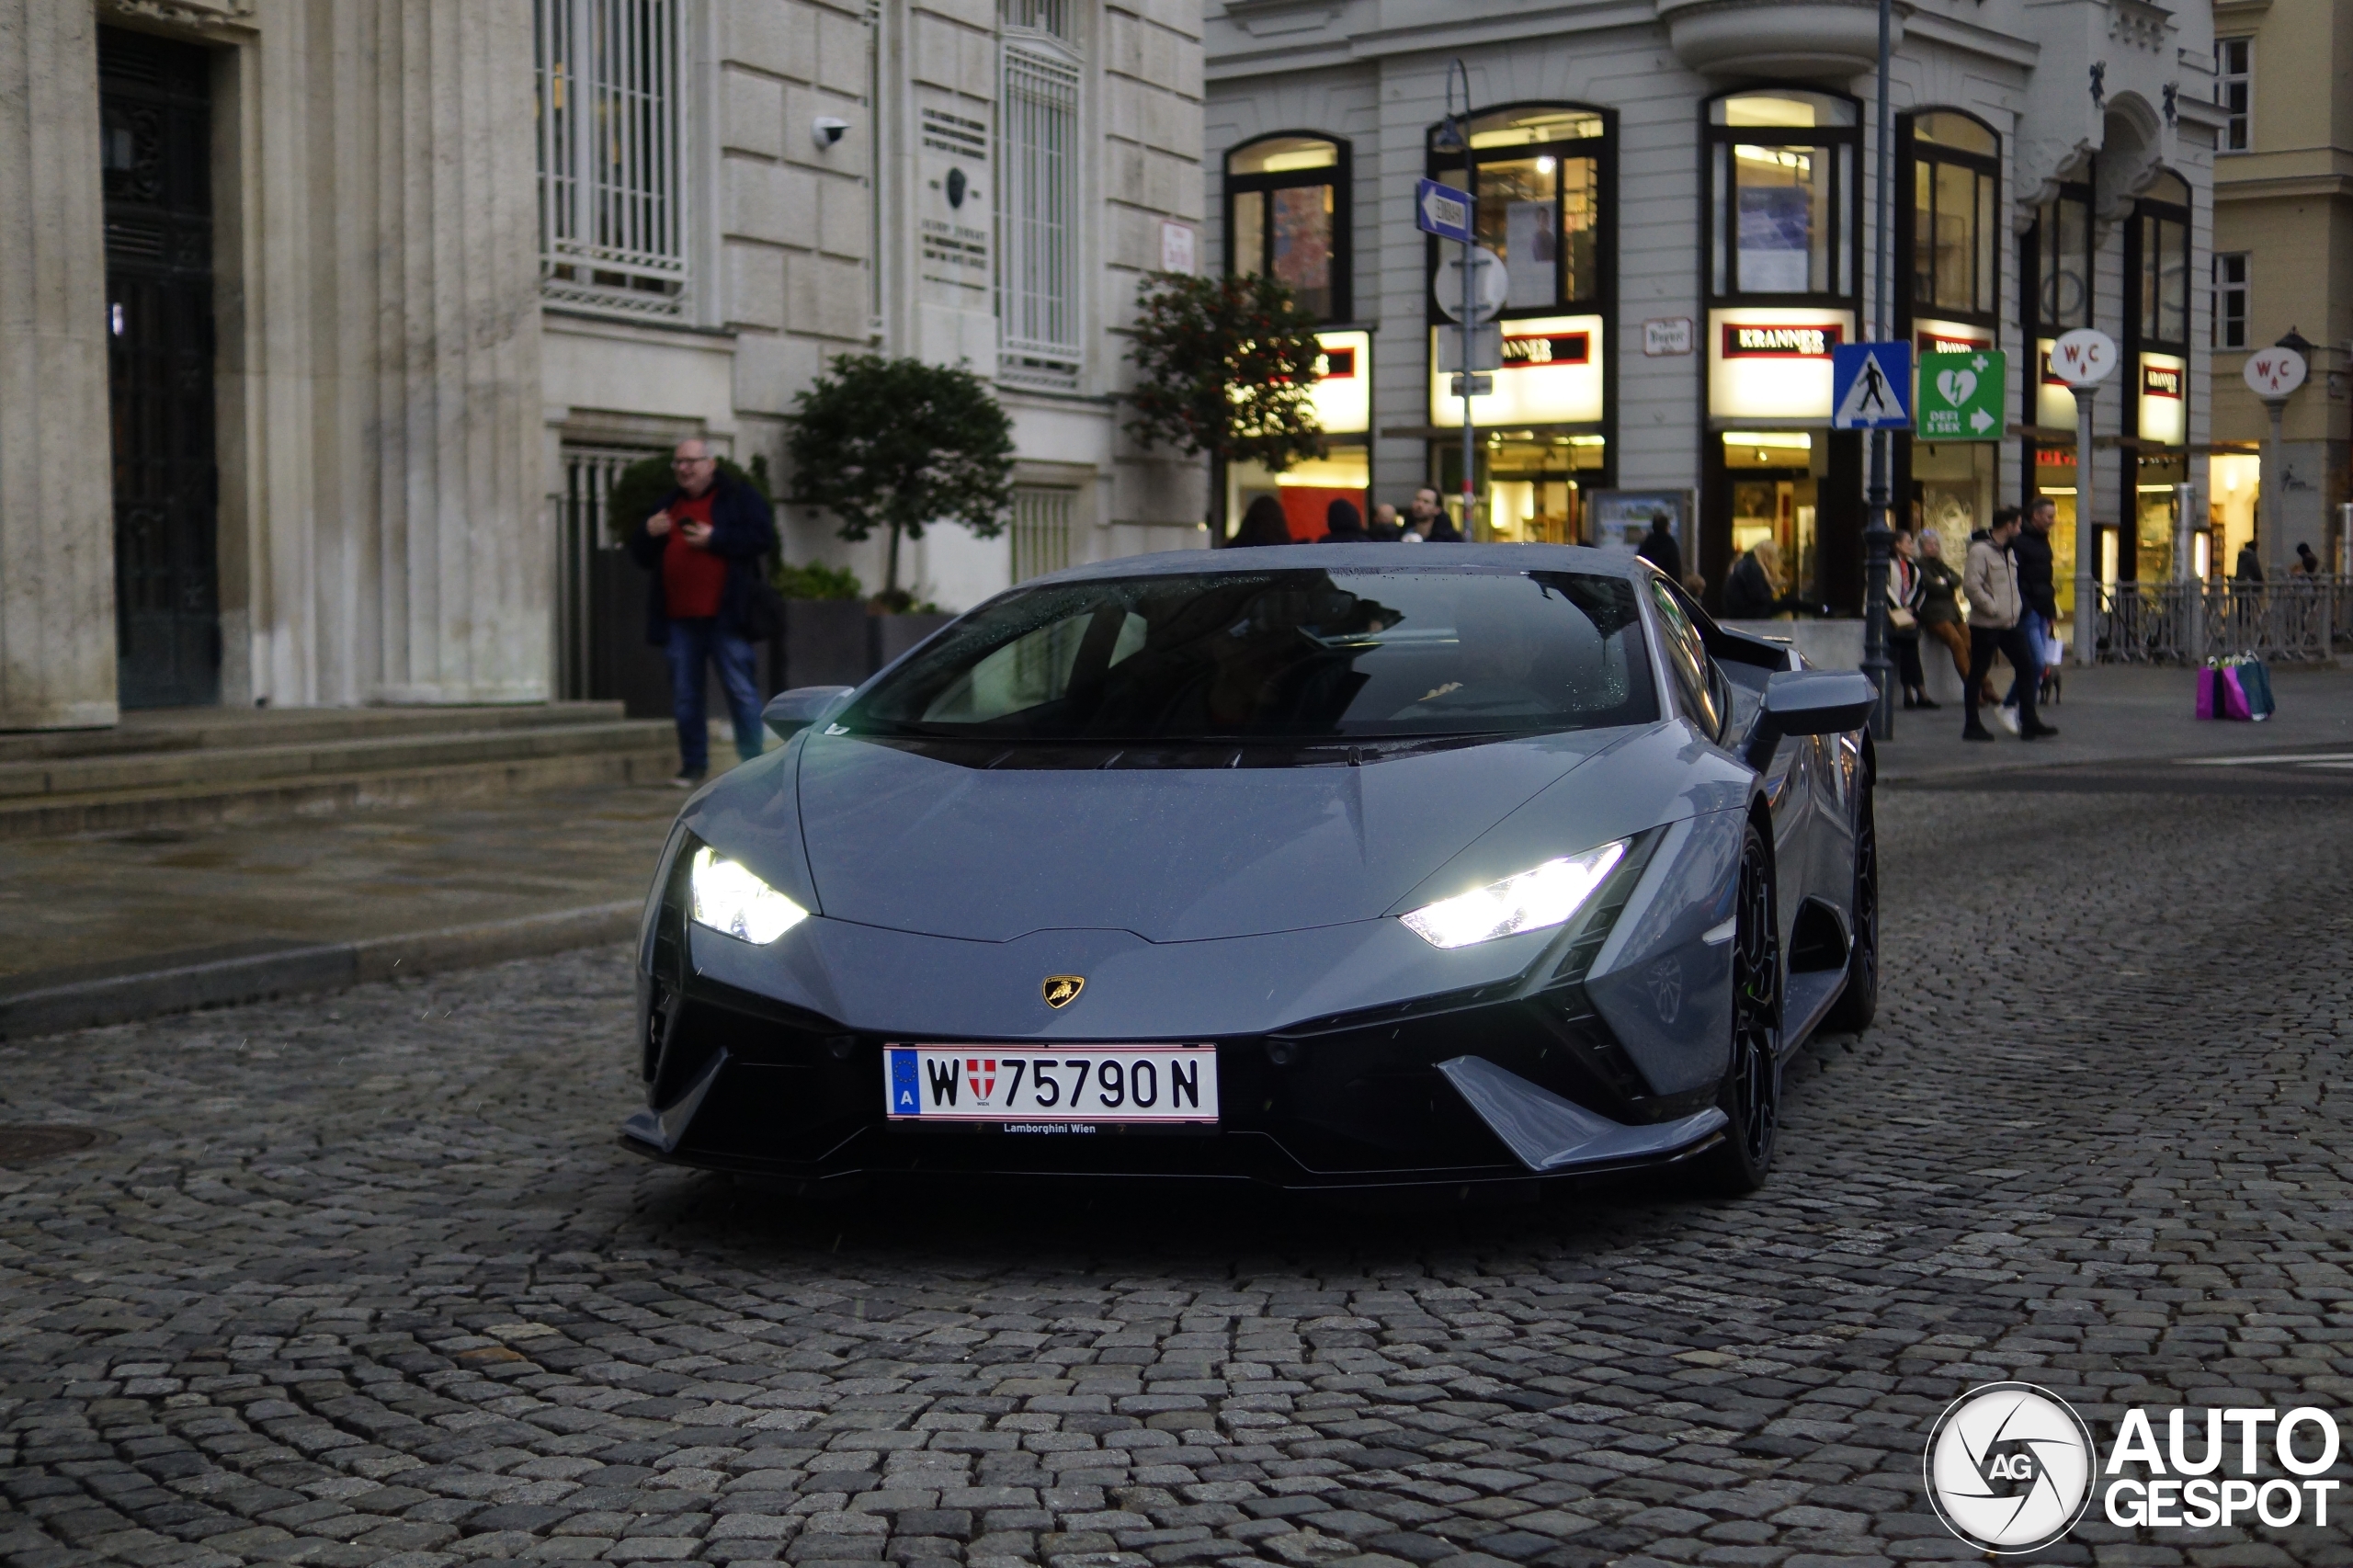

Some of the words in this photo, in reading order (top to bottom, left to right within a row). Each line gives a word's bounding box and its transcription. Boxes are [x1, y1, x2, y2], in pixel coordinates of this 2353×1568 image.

[1739, 329, 1824, 348] KRANNER
[1930, 410, 1958, 422] DEFI
[926, 1058, 960, 1107] W
[1001, 1059, 1158, 1108] 75790
[1171, 1059, 1199, 1108] N
[900, 1091, 914, 1106] A
[1004, 1123, 1068, 1134] Lamborghini
[1071, 1123, 1097, 1133] Wien
